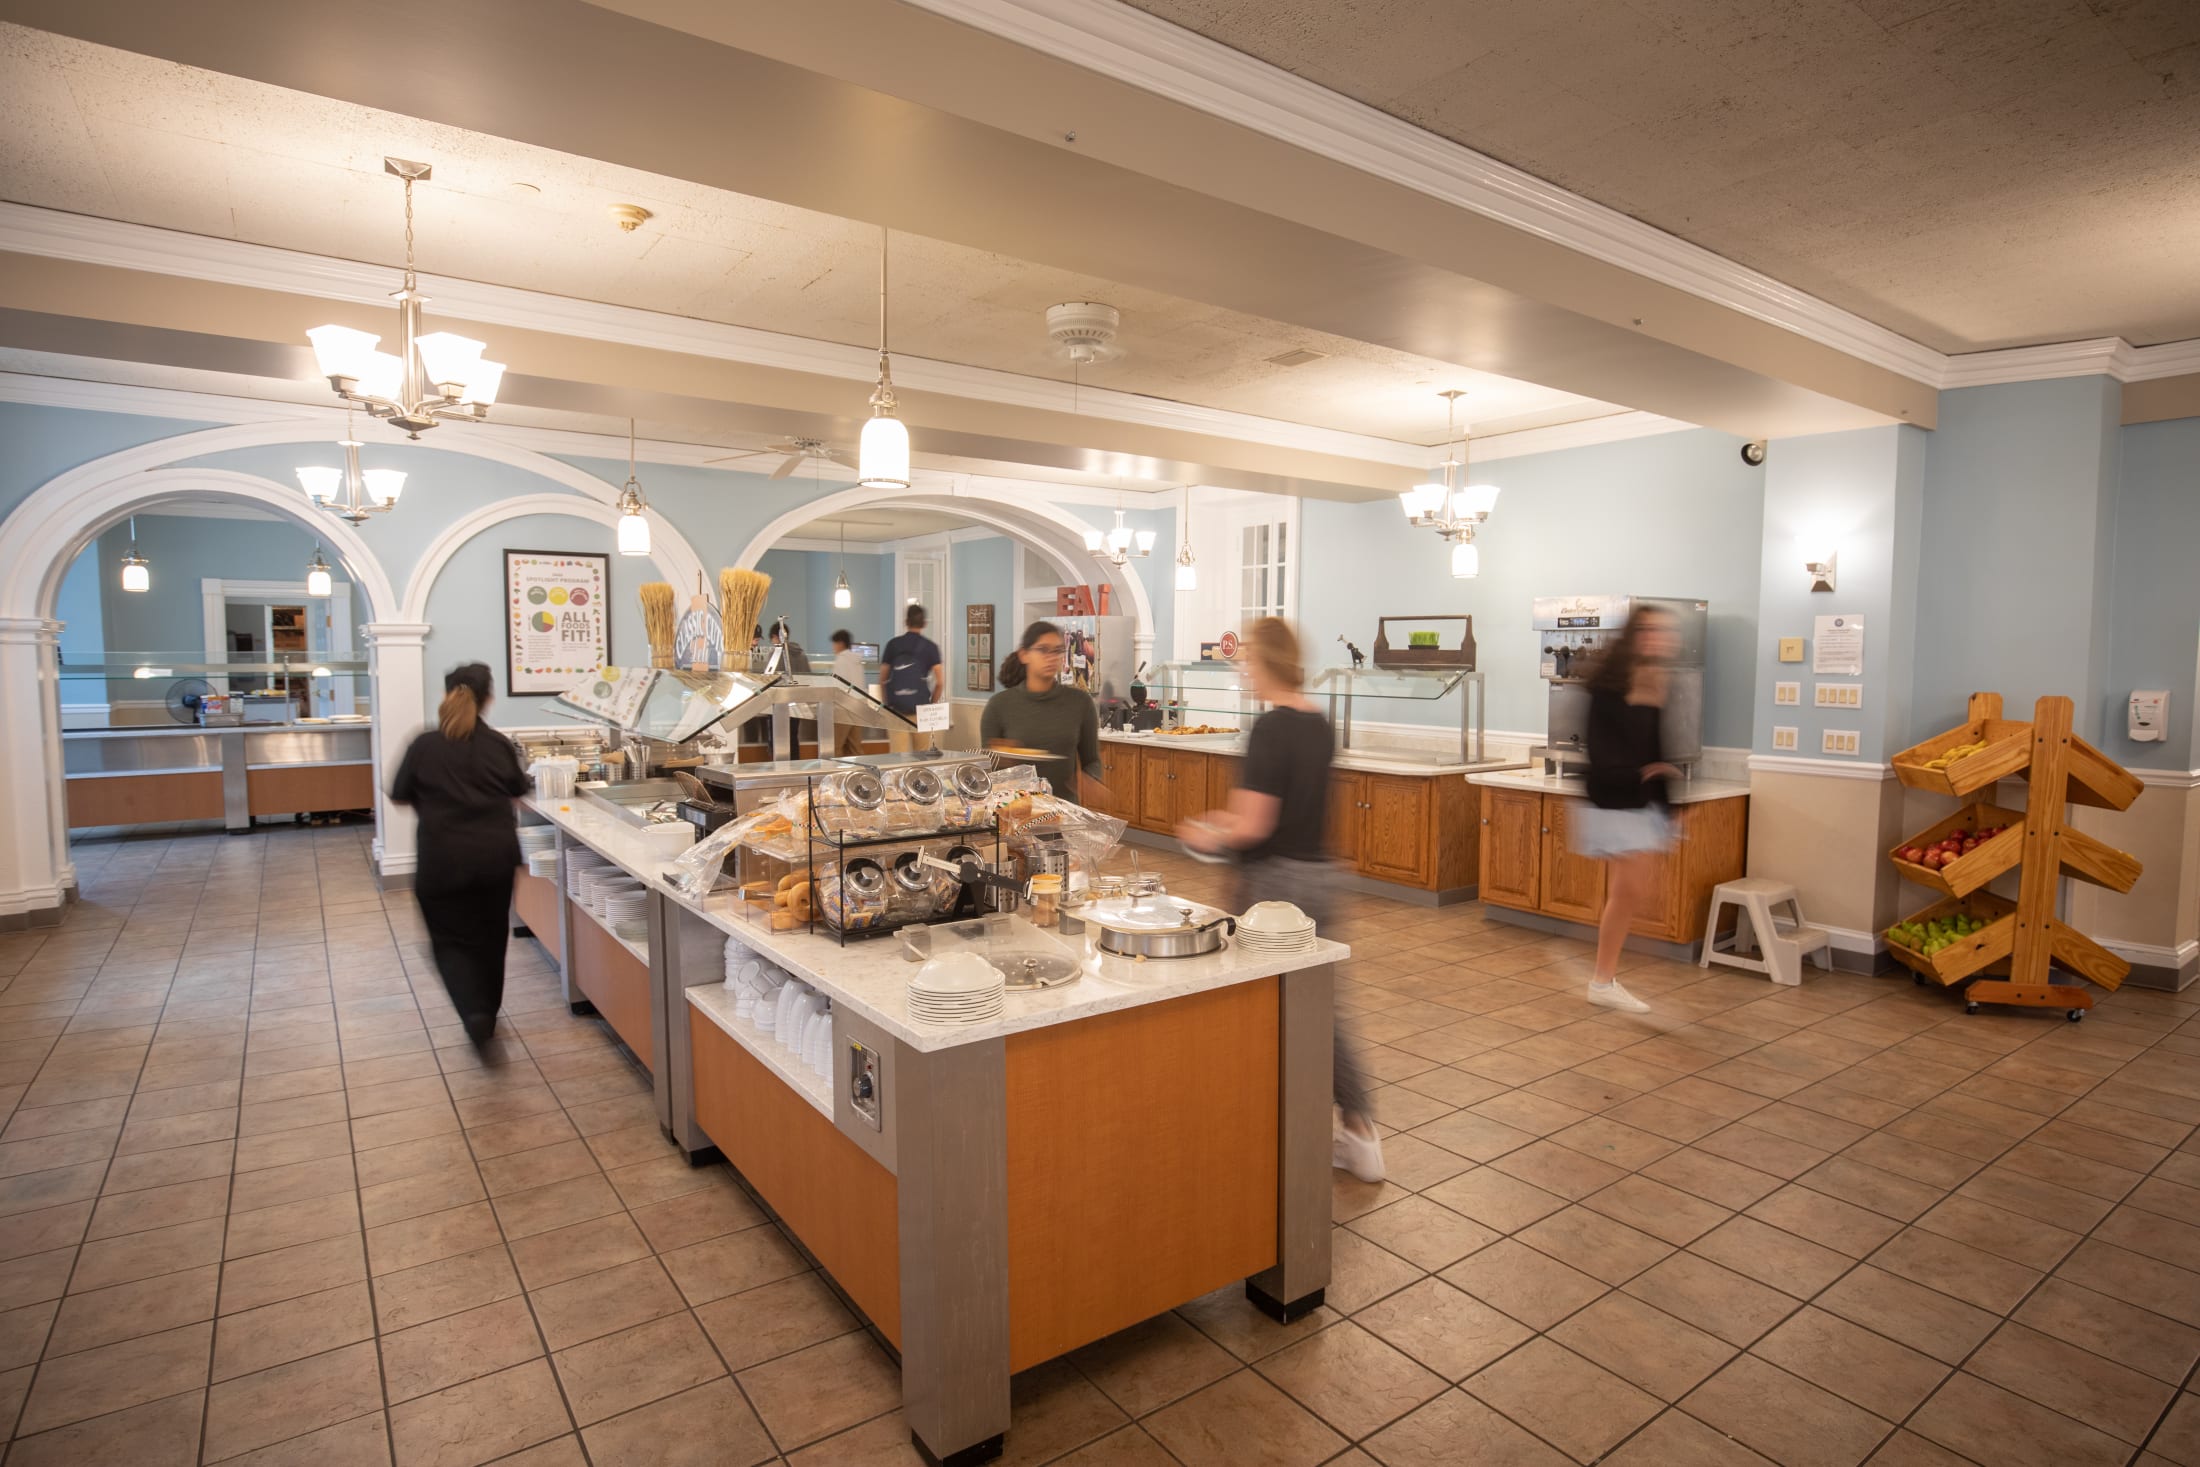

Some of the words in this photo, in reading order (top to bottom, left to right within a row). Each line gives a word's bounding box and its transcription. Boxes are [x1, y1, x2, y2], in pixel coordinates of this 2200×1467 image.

[562, 612, 590, 623] ALL
[561, 630, 591, 642] FIT!
[676, 610, 704, 659] CLASSIC
[1222, 640, 1235, 650] P.S.
